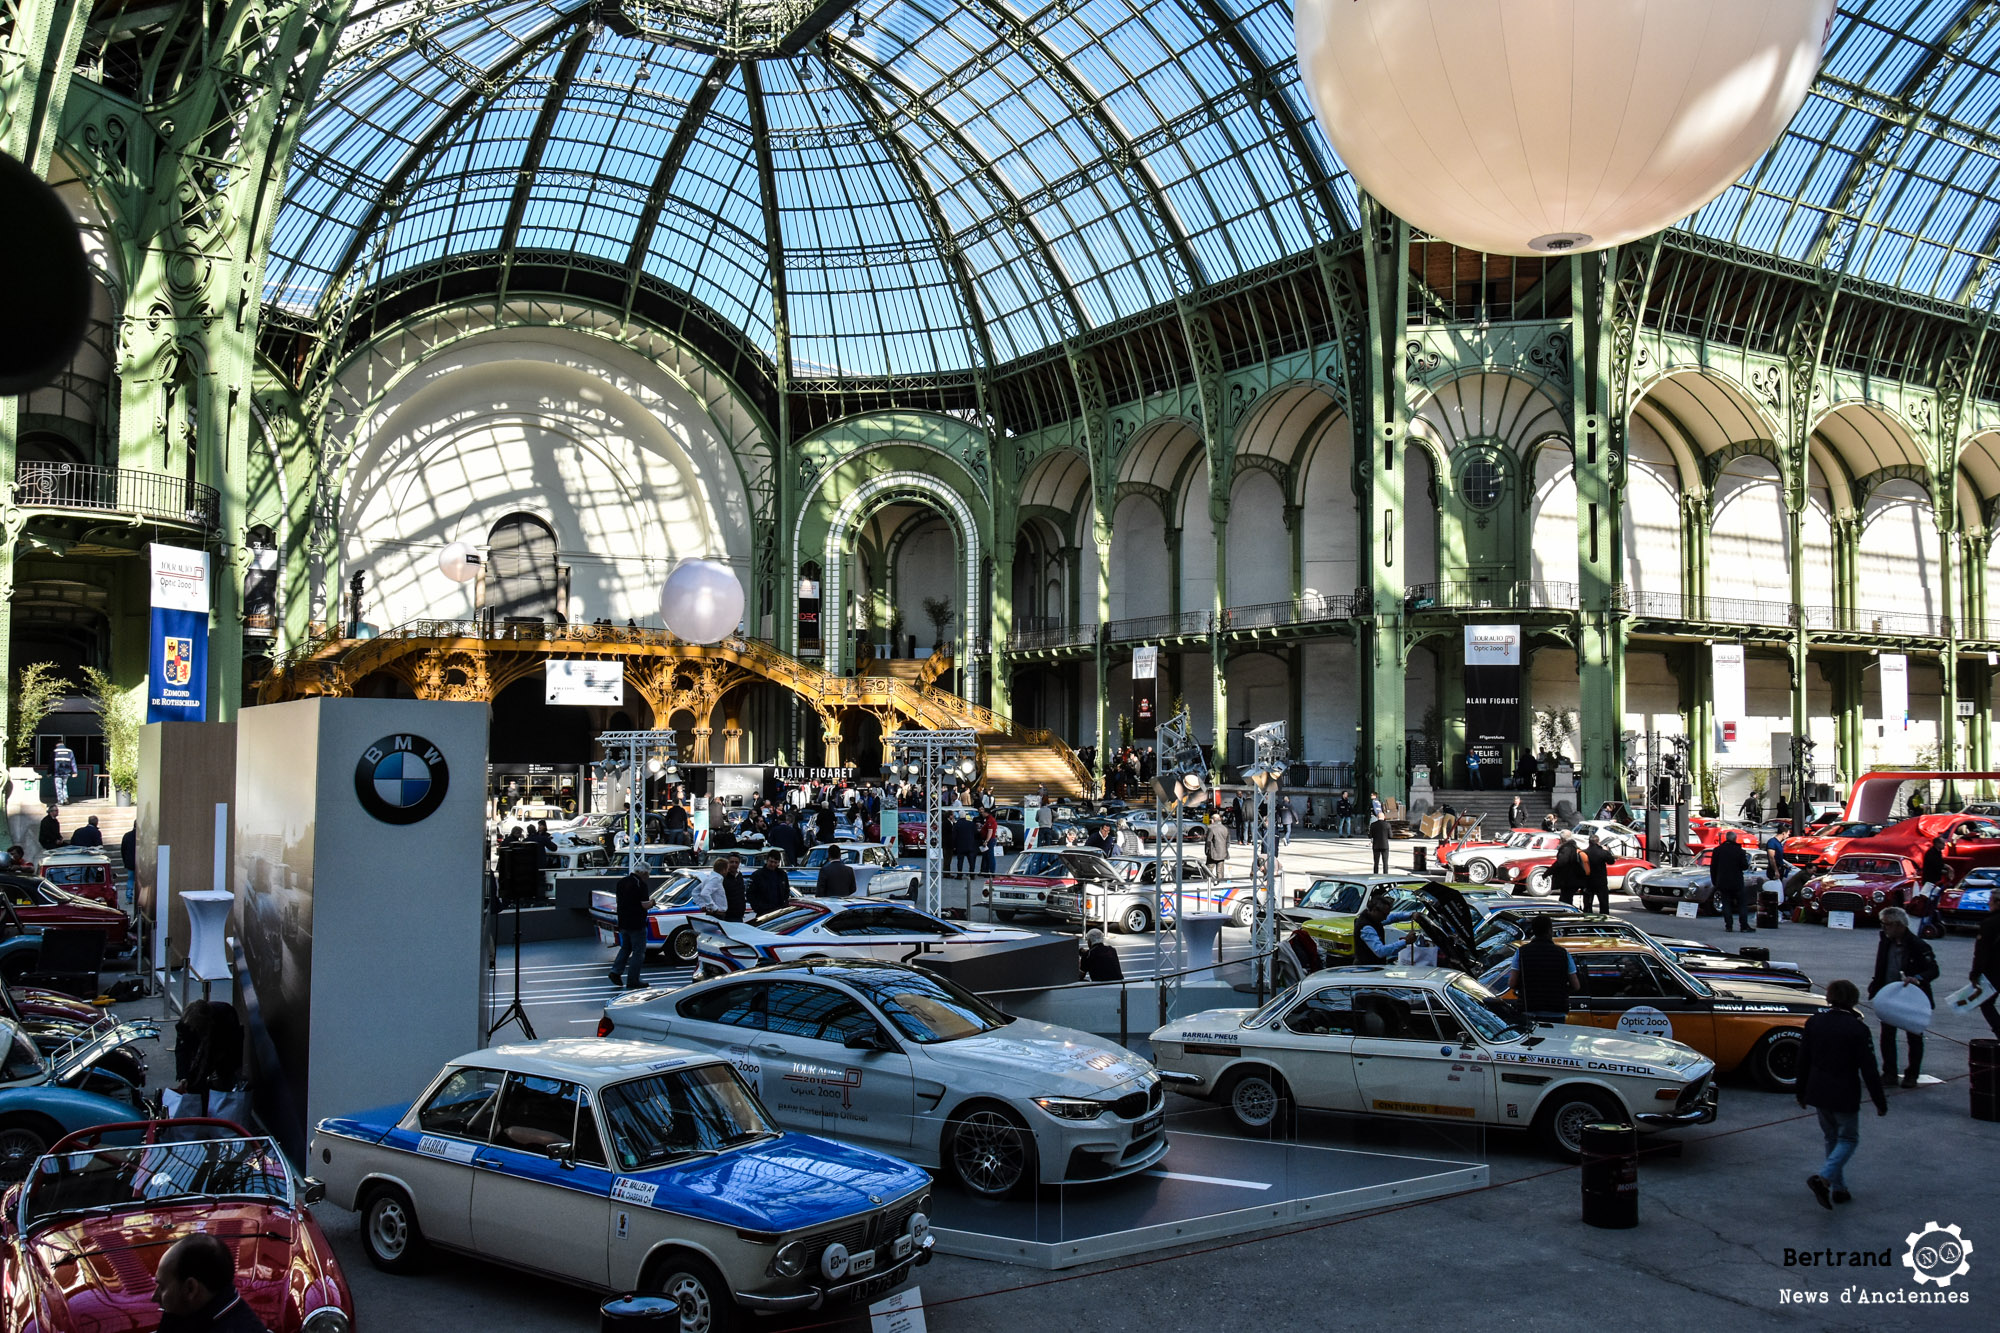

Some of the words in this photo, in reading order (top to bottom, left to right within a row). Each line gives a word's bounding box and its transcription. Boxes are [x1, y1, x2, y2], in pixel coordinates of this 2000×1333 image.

[163, 688, 190, 698] EDMOND
[161, 698, 200, 707] ROTHSCHILD
[364, 735, 442, 765] BMW
[773, 767, 805, 778] ALAIN
[810, 767, 853, 778] FIGARET
[1745, 1004, 1789, 1012] ALPINA
[1621, 1017, 1645, 1028] Optic
[1647, 1017, 1669, 1026] 2000
[1768, 1031, 1803, 1044] MICHE
[738, 1060, 760, 1073] 2000
[1537, 1057, 1581, 1067] MARCHAL
[1588, 1061, 1655, 1075] CASTROL
[792, 1062, 816, 1075] TOUR
[803, 1076, 828, 1085] 2016
[818, 1087, 841, 1099] 2000
[418, 1137, 449, 1155] CHABRAN
[854, 1258, 872, 1270] IPF
